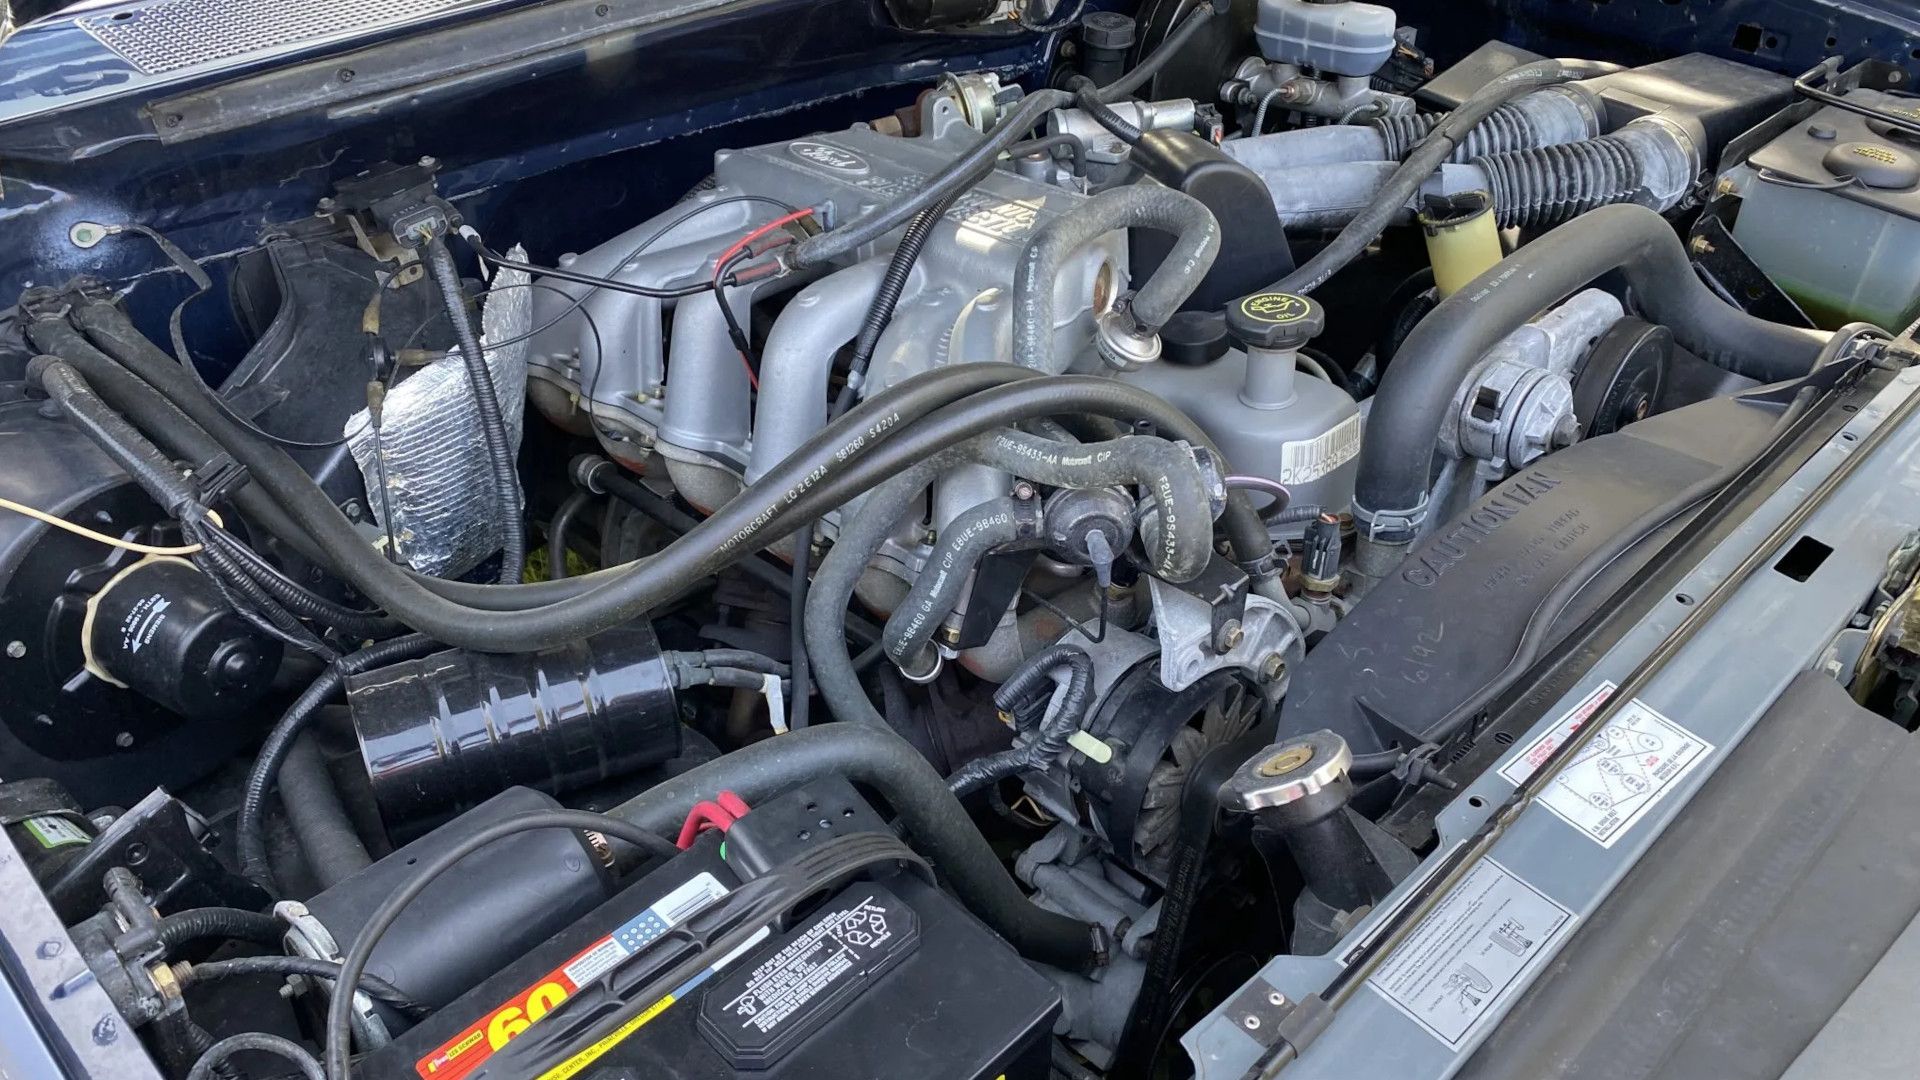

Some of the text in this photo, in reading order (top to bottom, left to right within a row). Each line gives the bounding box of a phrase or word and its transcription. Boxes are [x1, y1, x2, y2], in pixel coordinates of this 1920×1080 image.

[801, 147, 855, 168] Ford
[1250, 295, 1289, 305] ENGINE
[1097, 450, 1111, 462] CIP
[718, 503, 781, 554] MOTORCRAFT
[866, 410, 901, 440] S420A
[1402, 500, 1519, 586] CAUTION
[920, 598, 934, 613] GA
[942, 551, 953, 568] CIP
[144, 613, 166, 645] SIEMENS
[751, 940, 825, 997] FLUSH EYES IMMEDIATELY
[756, 985, 776, 1001] WITH
[794, 960, 809, 973] GET
[761, 960, 818, 1006] MEDICAL HELP FAST
[487, 982, 569, 1052] 60
[447, 1031, 482, 1057] LES SCHWAB
